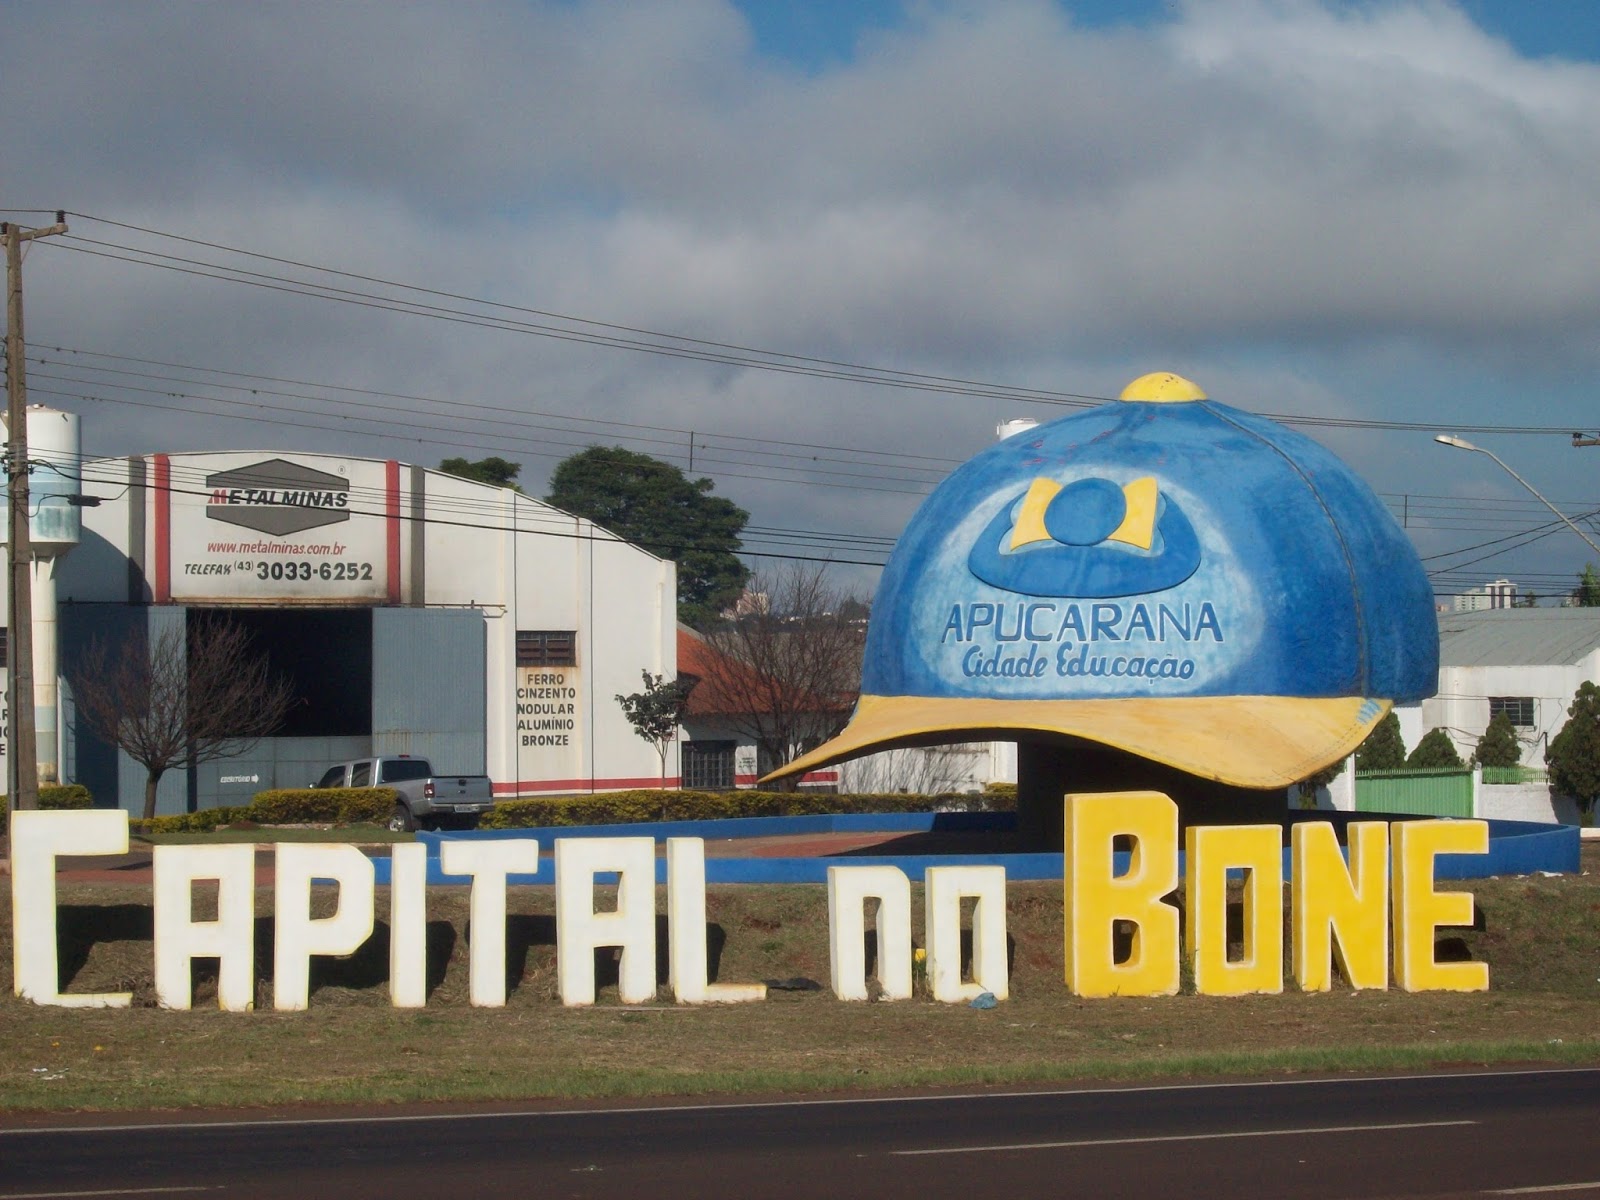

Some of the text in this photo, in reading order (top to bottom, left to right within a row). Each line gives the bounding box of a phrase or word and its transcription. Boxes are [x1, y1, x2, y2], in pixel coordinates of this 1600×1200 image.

[208, 489, 349, 508] METALMINAS
[207, 540, 346, 556] www.metalminas.com.br
[184, 559, 373, 581] TELEFAX (43) 3033-6252
[941, 602, 1224, 643] APUCARANA
[962, 641, 1195, 684] Cidade Educação
[527, 673, 565, 685] FERRO
[516, 687, 576, 699] CINZENTO
[516, 703, 575, 715] NODULAR
[516, 716, 574, 731] ALUMÍNIO
[521, 735, 569, 746] BRONZE
[11, 809, 768, 1012] CAPITAL
[1064, 790, 1490, 997] BONE
